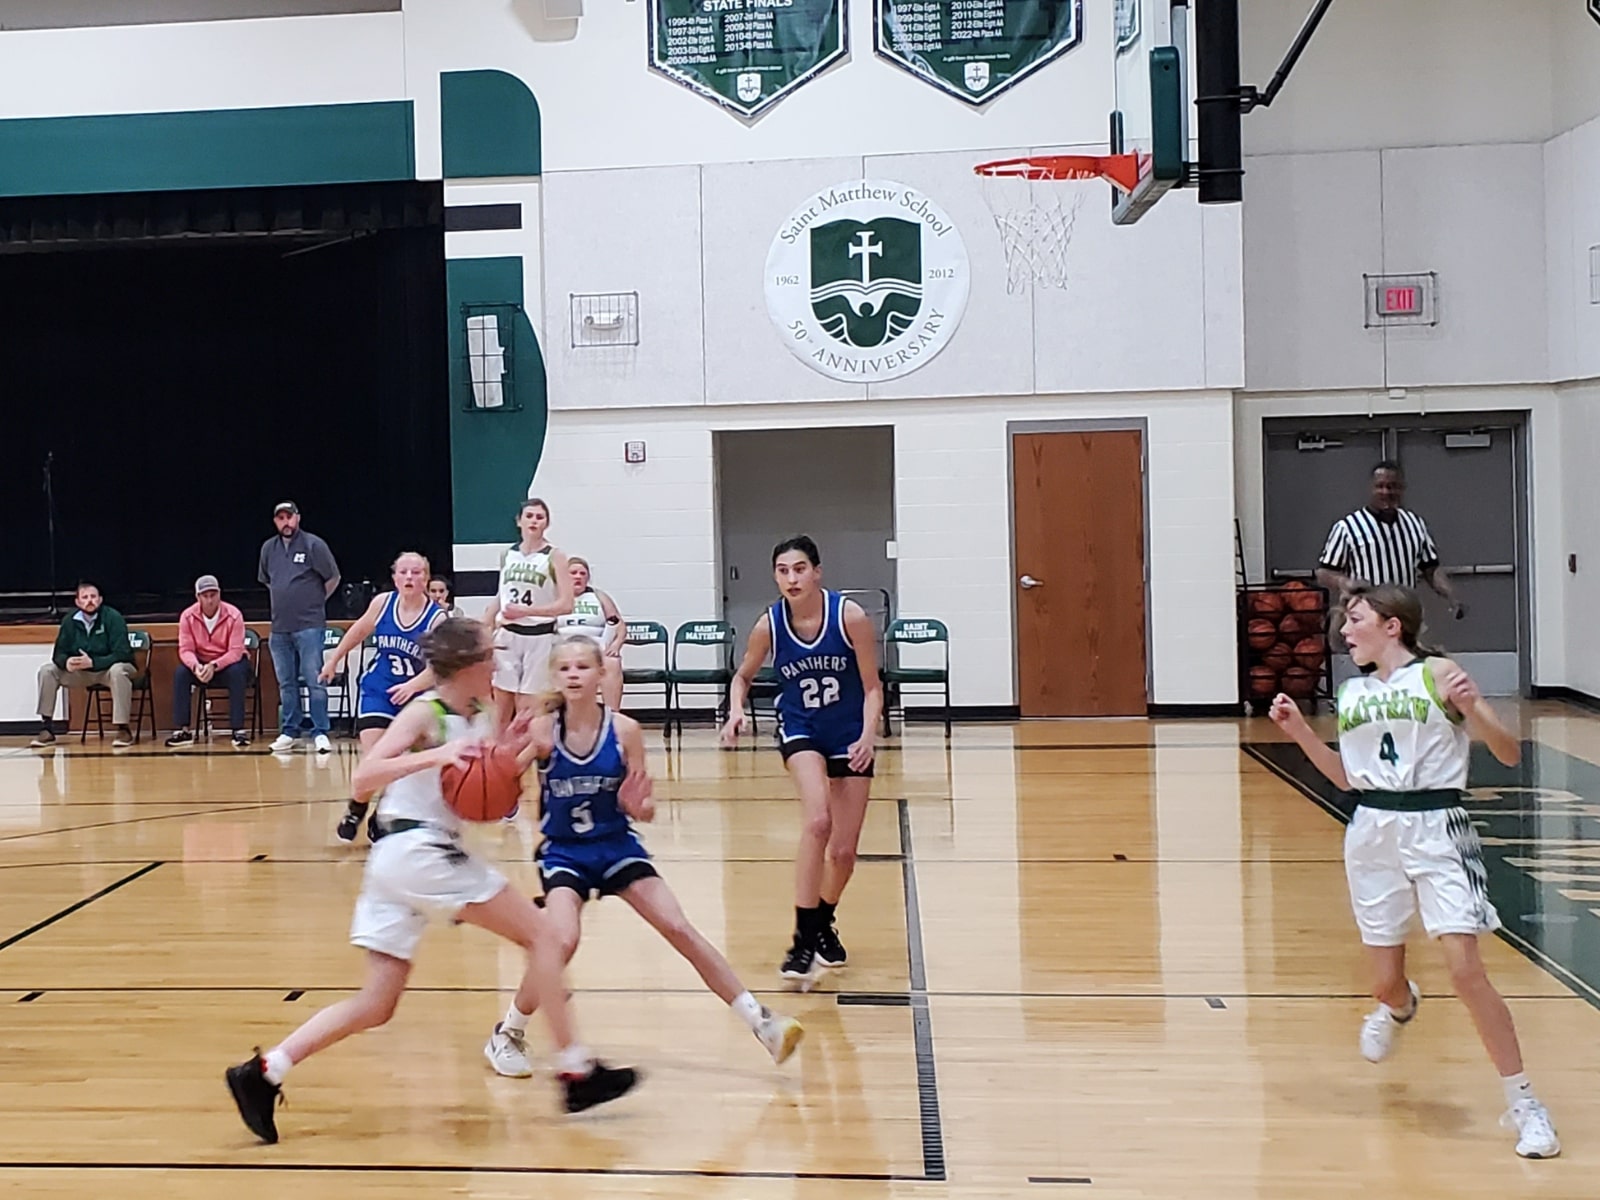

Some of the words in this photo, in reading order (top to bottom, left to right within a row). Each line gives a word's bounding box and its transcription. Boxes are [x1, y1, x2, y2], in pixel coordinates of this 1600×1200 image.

[703, 0, 744, 12] STATE
[746, 0, 793, 8] FINALS
[780, 207, 819, 245] Saint
[818, 183, 897, 211] Matthew
[899, 191, 953, 237] School
[775, 275, 800, 286] 1962
[928, 268, 955, 279] 2012
[1385, 288, 1415, 311] EXIT
[812, 308, 945, 374] ANNIVERSARY
[510, 588, 533, 606] 34
[685, 630, 725, 641] MATTHEW
[693, 624, 718, 633] SAINT
[894, 629, 938, 639] MATTHEW
[903, 622, 929, 631] SAINT
[626, 631, 659, 641] ATTHEW
[388, 654, 416, 676] 31
[781, 655, 848, 680] PANTHERS
[799, 676, 841, 709] 22
[1378, 731, 1400, 768] 4
[570, 800, 596, 834] 5
